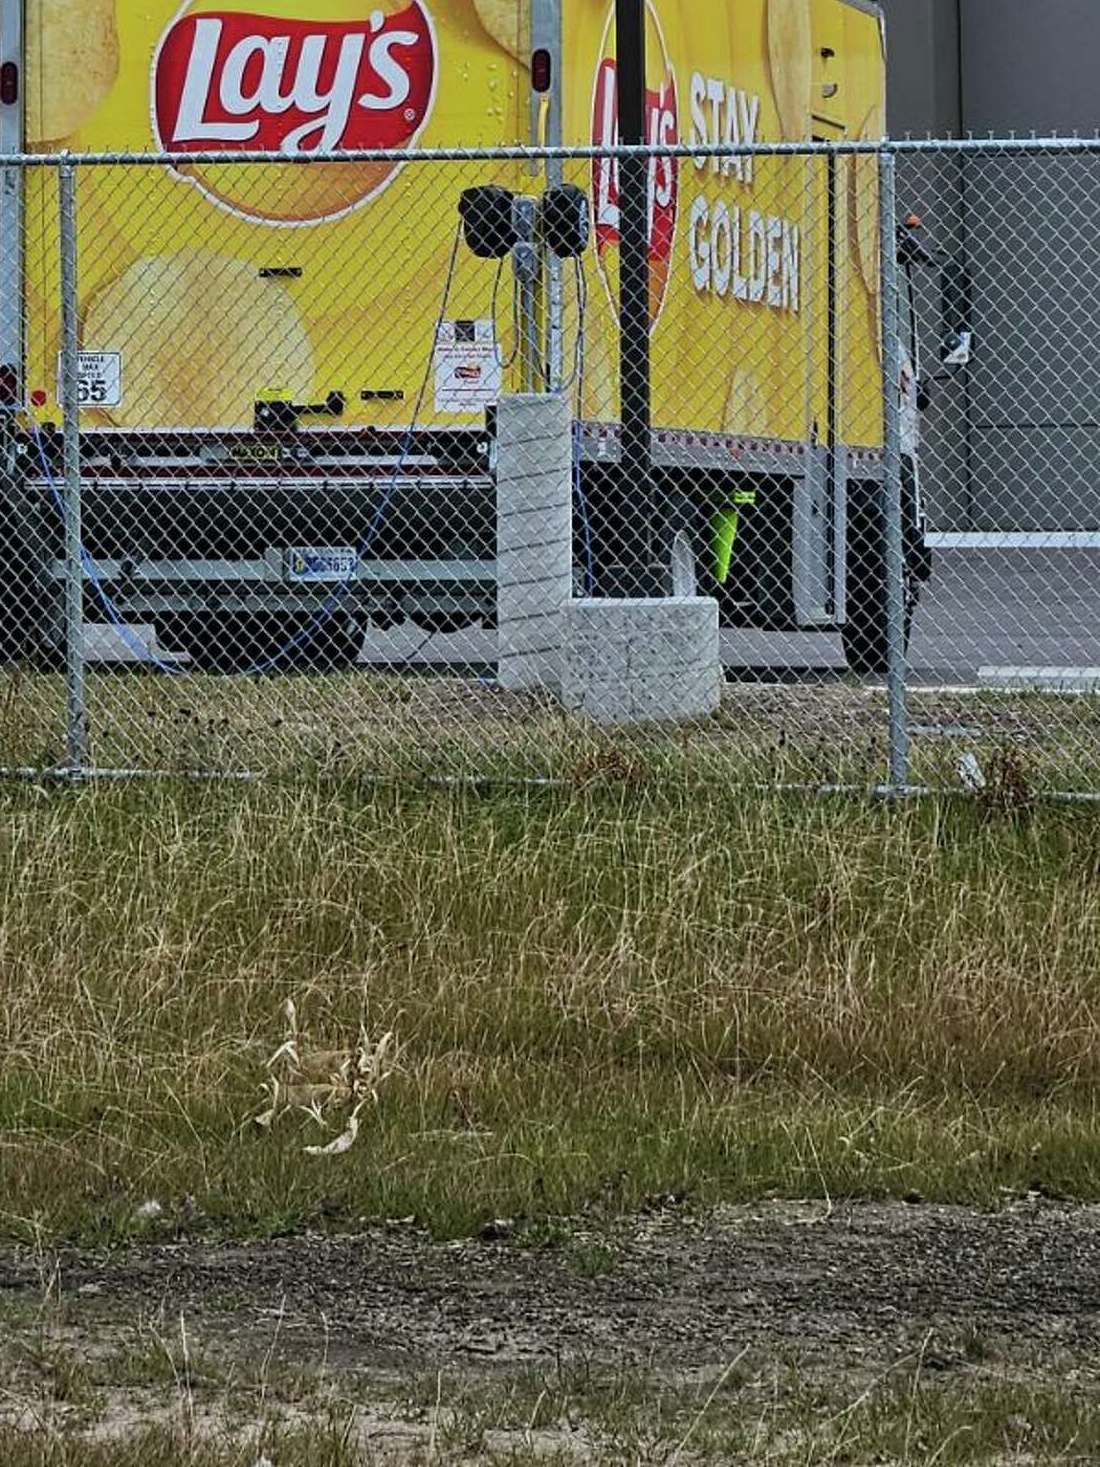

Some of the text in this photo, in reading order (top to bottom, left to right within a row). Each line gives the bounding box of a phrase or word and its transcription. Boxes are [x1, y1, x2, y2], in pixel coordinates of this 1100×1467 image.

[172, 9, 419, 154] Lay's
[690, 70, 759, 183] STAY
[690, 193, 798, 311] GOLDEN
